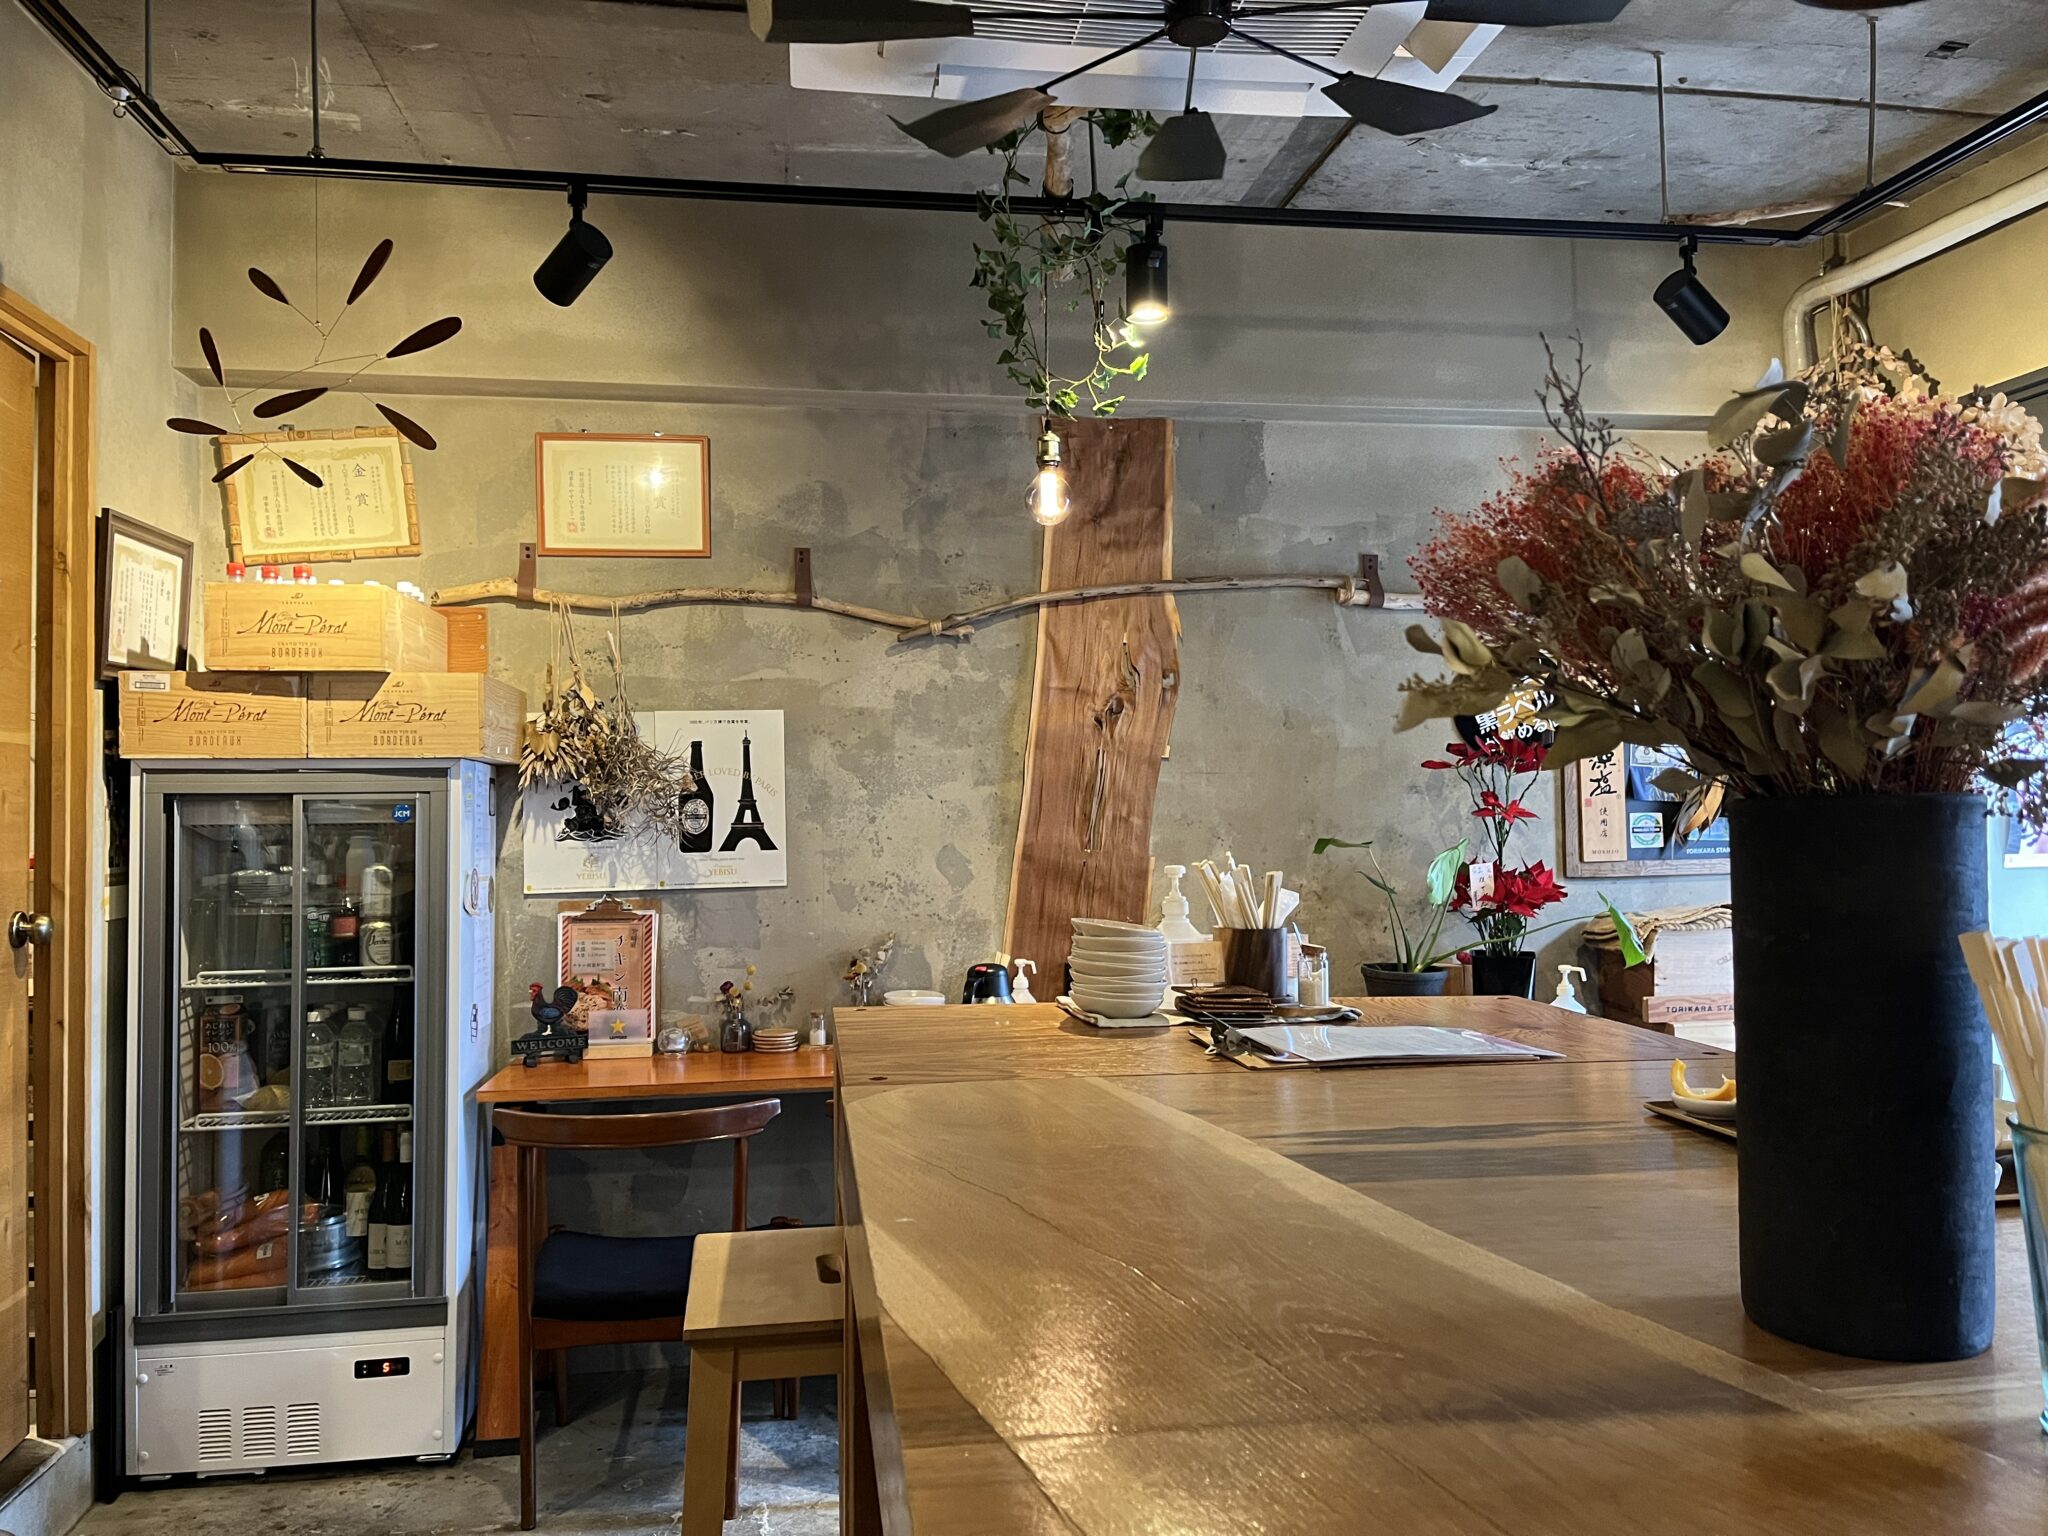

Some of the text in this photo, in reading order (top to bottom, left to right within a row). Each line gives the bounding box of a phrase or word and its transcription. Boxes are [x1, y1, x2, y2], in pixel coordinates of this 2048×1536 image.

[352, 463, 369, 507] 金賞
[271, 647, 324, 658] BORDEAUX
[188, 735, 242, 746] BORDEAUX
[373, 735, 424, 746] BORDEAUX
[708, 767, 741, 777] LOVED
[755, 776, 778, 798] PARIS
[394, 810, 411, 818] JCM
[1665, 1005, 1713, 1014] TORIKARA
[207, 1041, 238, 1054] 100%
[516, 1037, 586, 1051] WELCOME
